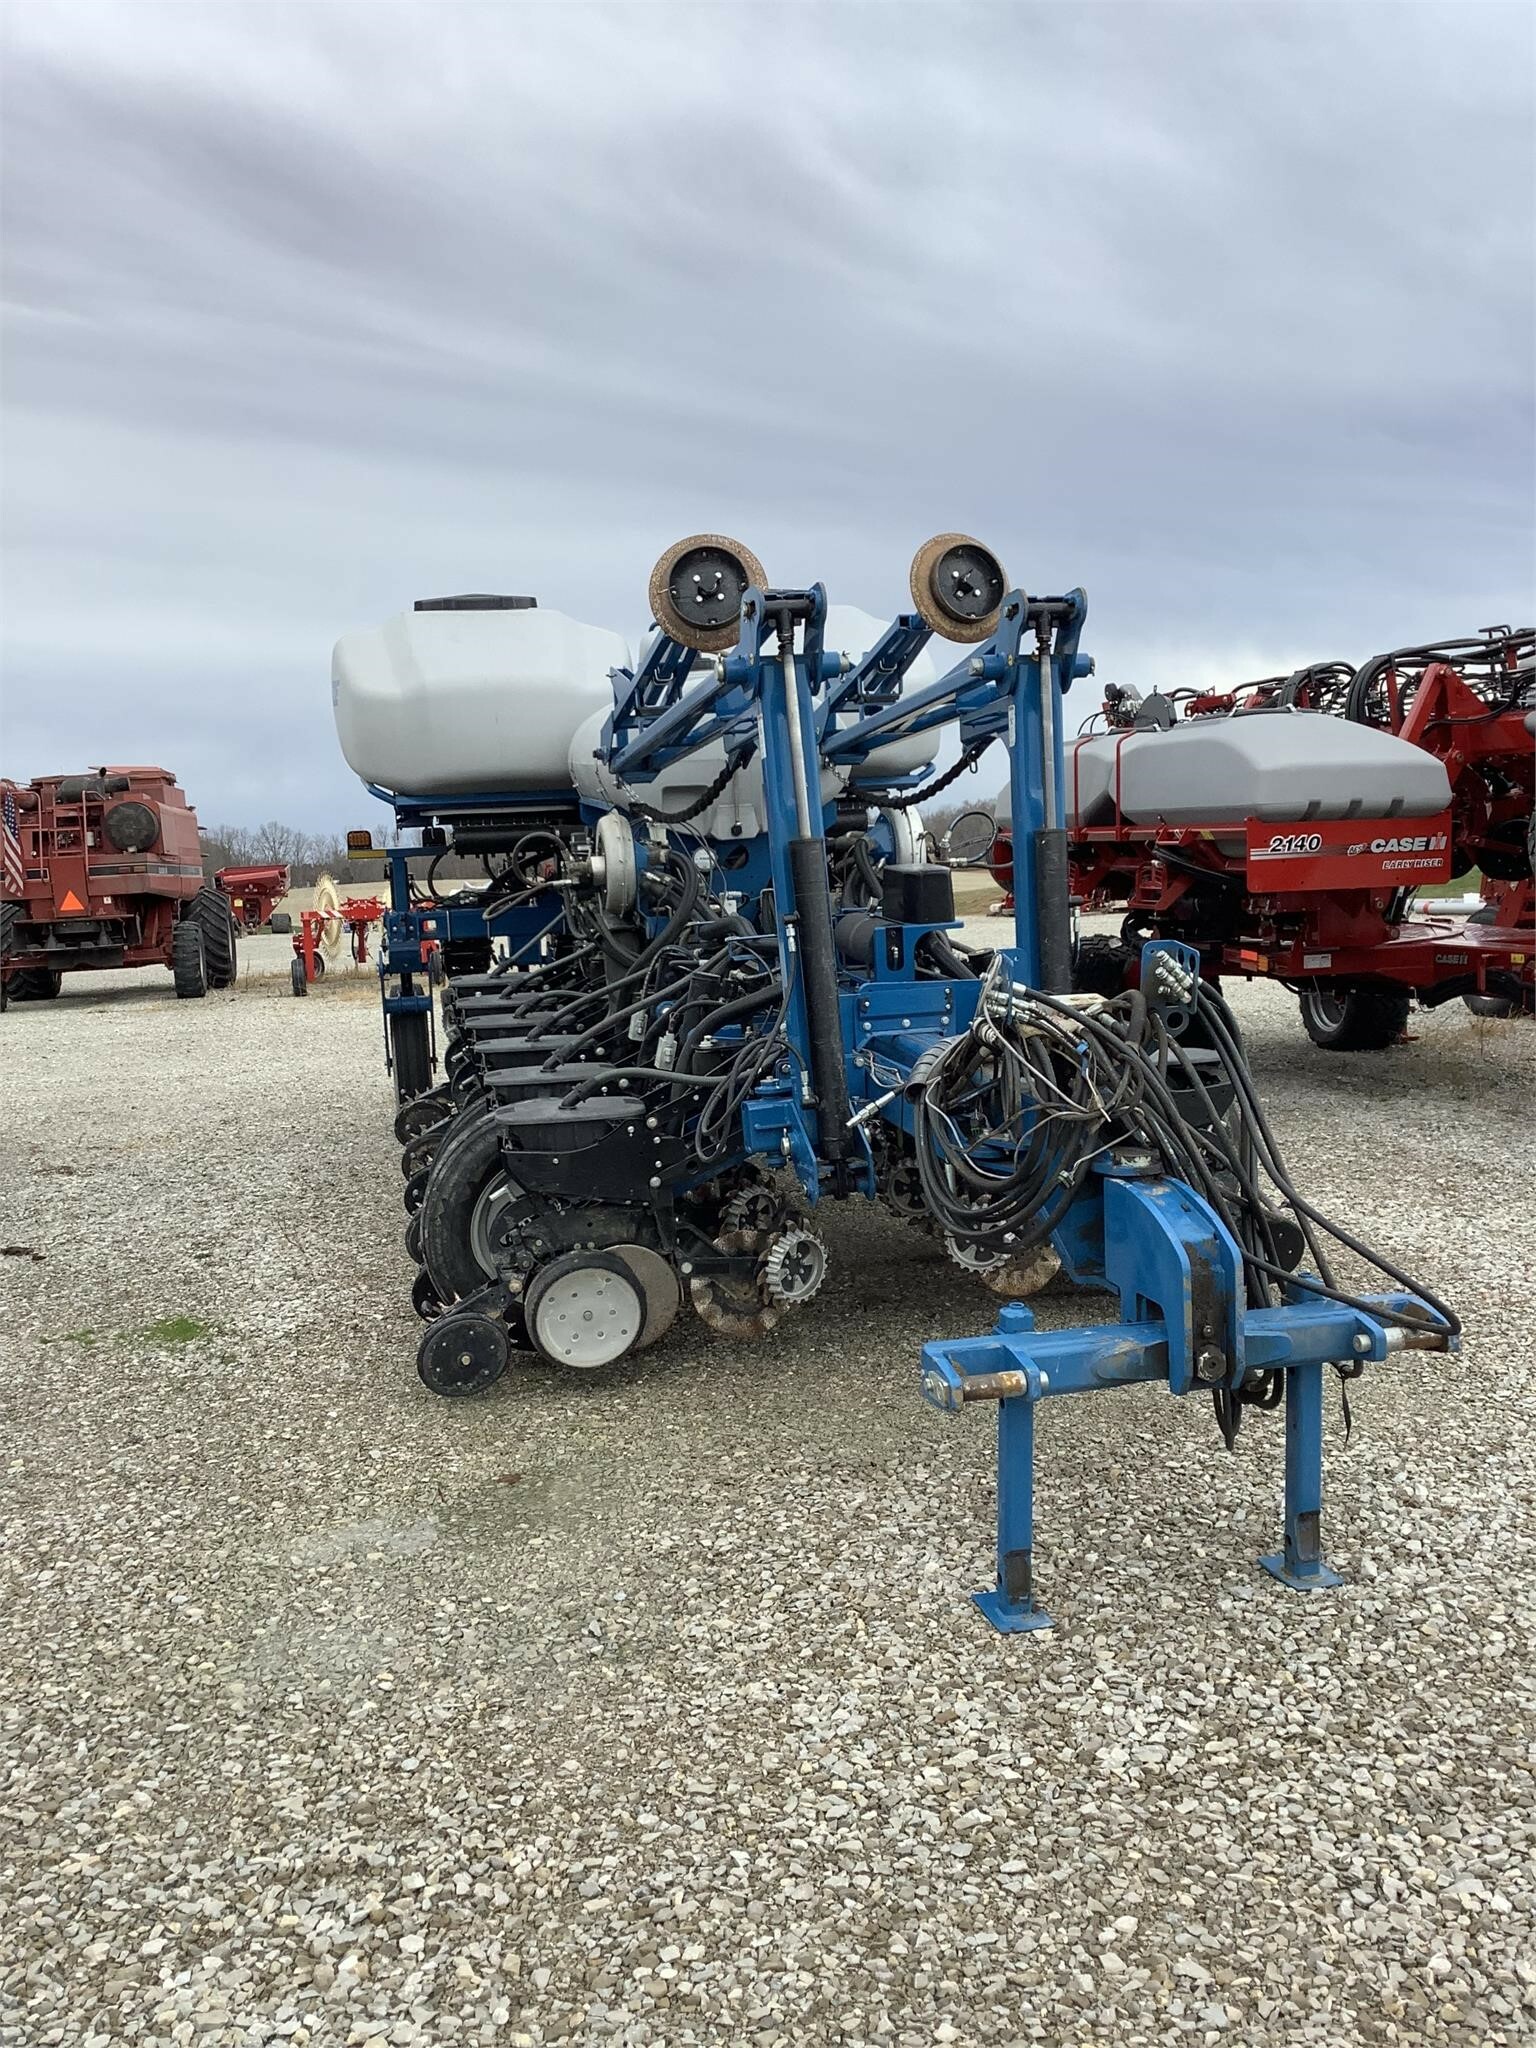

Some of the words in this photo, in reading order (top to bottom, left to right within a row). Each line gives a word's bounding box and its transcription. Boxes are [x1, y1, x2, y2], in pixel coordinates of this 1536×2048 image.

[1269, 834, 1322, 853] 2140
[1370, 837, 1427, 853] CASE
[1382, 859, 1415, 870] EARLY
[1414, 858, 1443, 868] RISER
[1436, 954, 1459, 964] CASE
